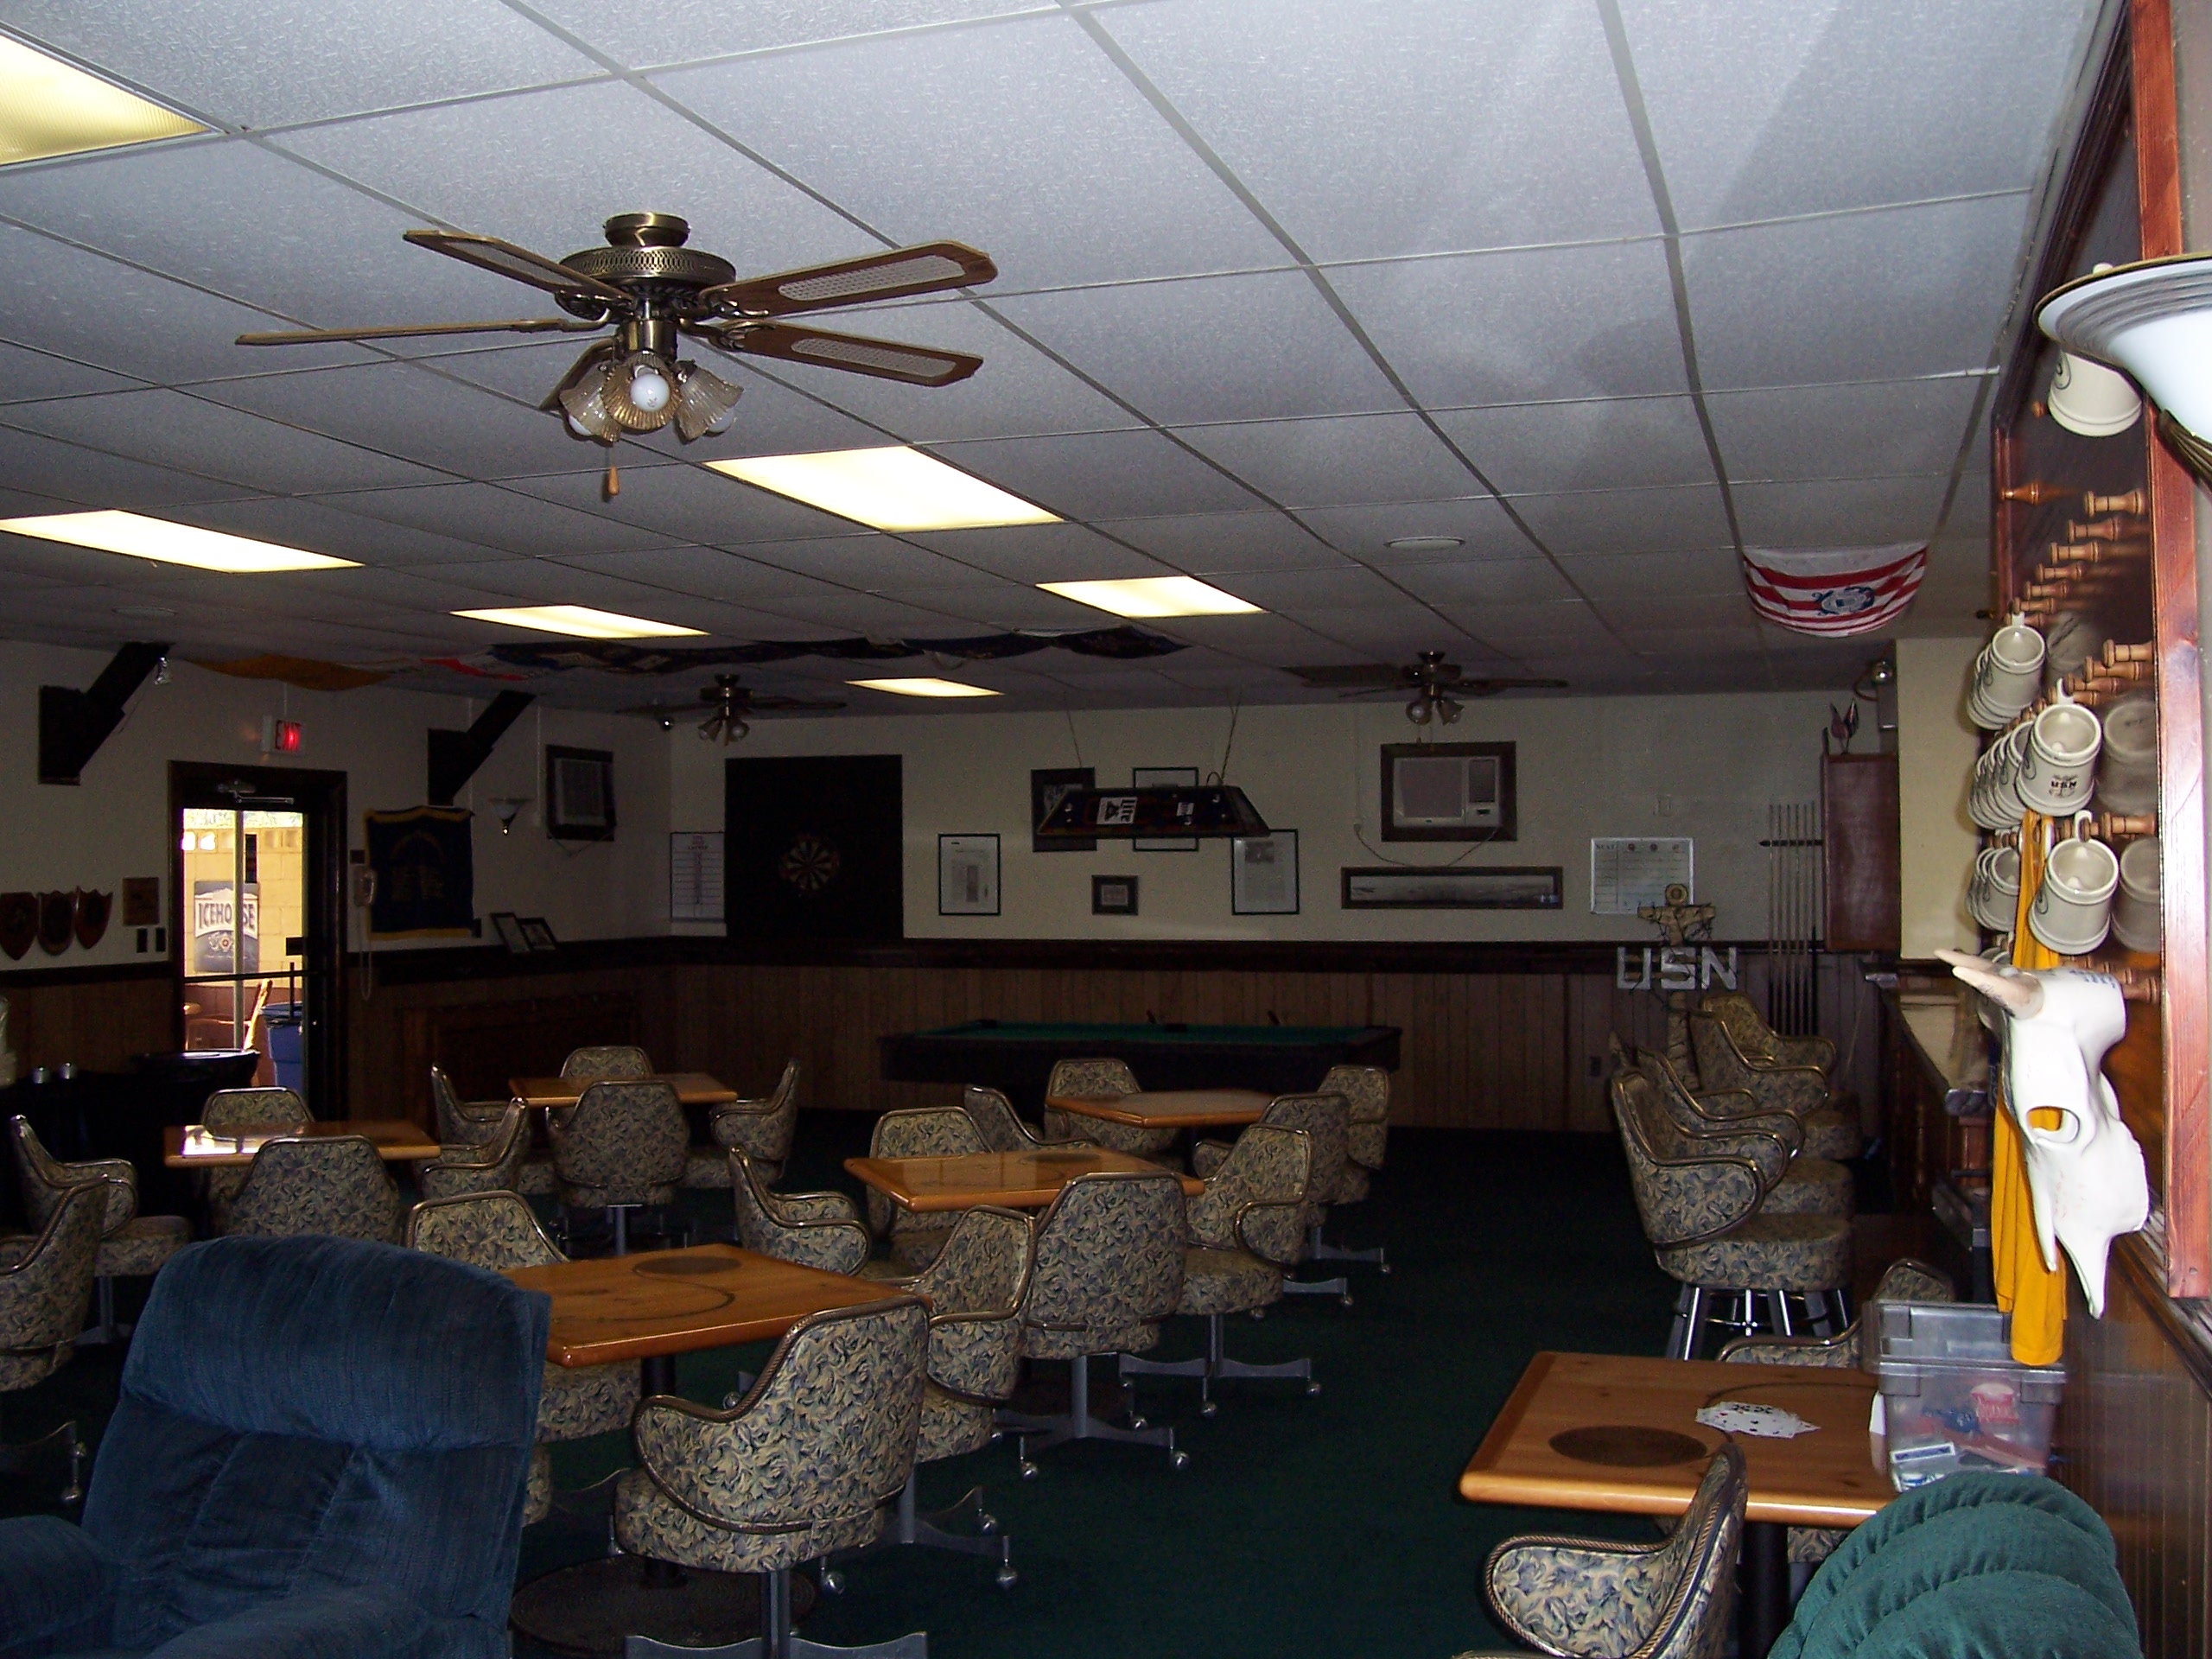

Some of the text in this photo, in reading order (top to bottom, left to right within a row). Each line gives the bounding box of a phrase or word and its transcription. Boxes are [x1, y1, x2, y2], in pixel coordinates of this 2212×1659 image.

[276, 720, 301, 752] EXIT
[198, 902, 255, 929] ICEHOSE
[1617, 945, 1738, 991] USN
